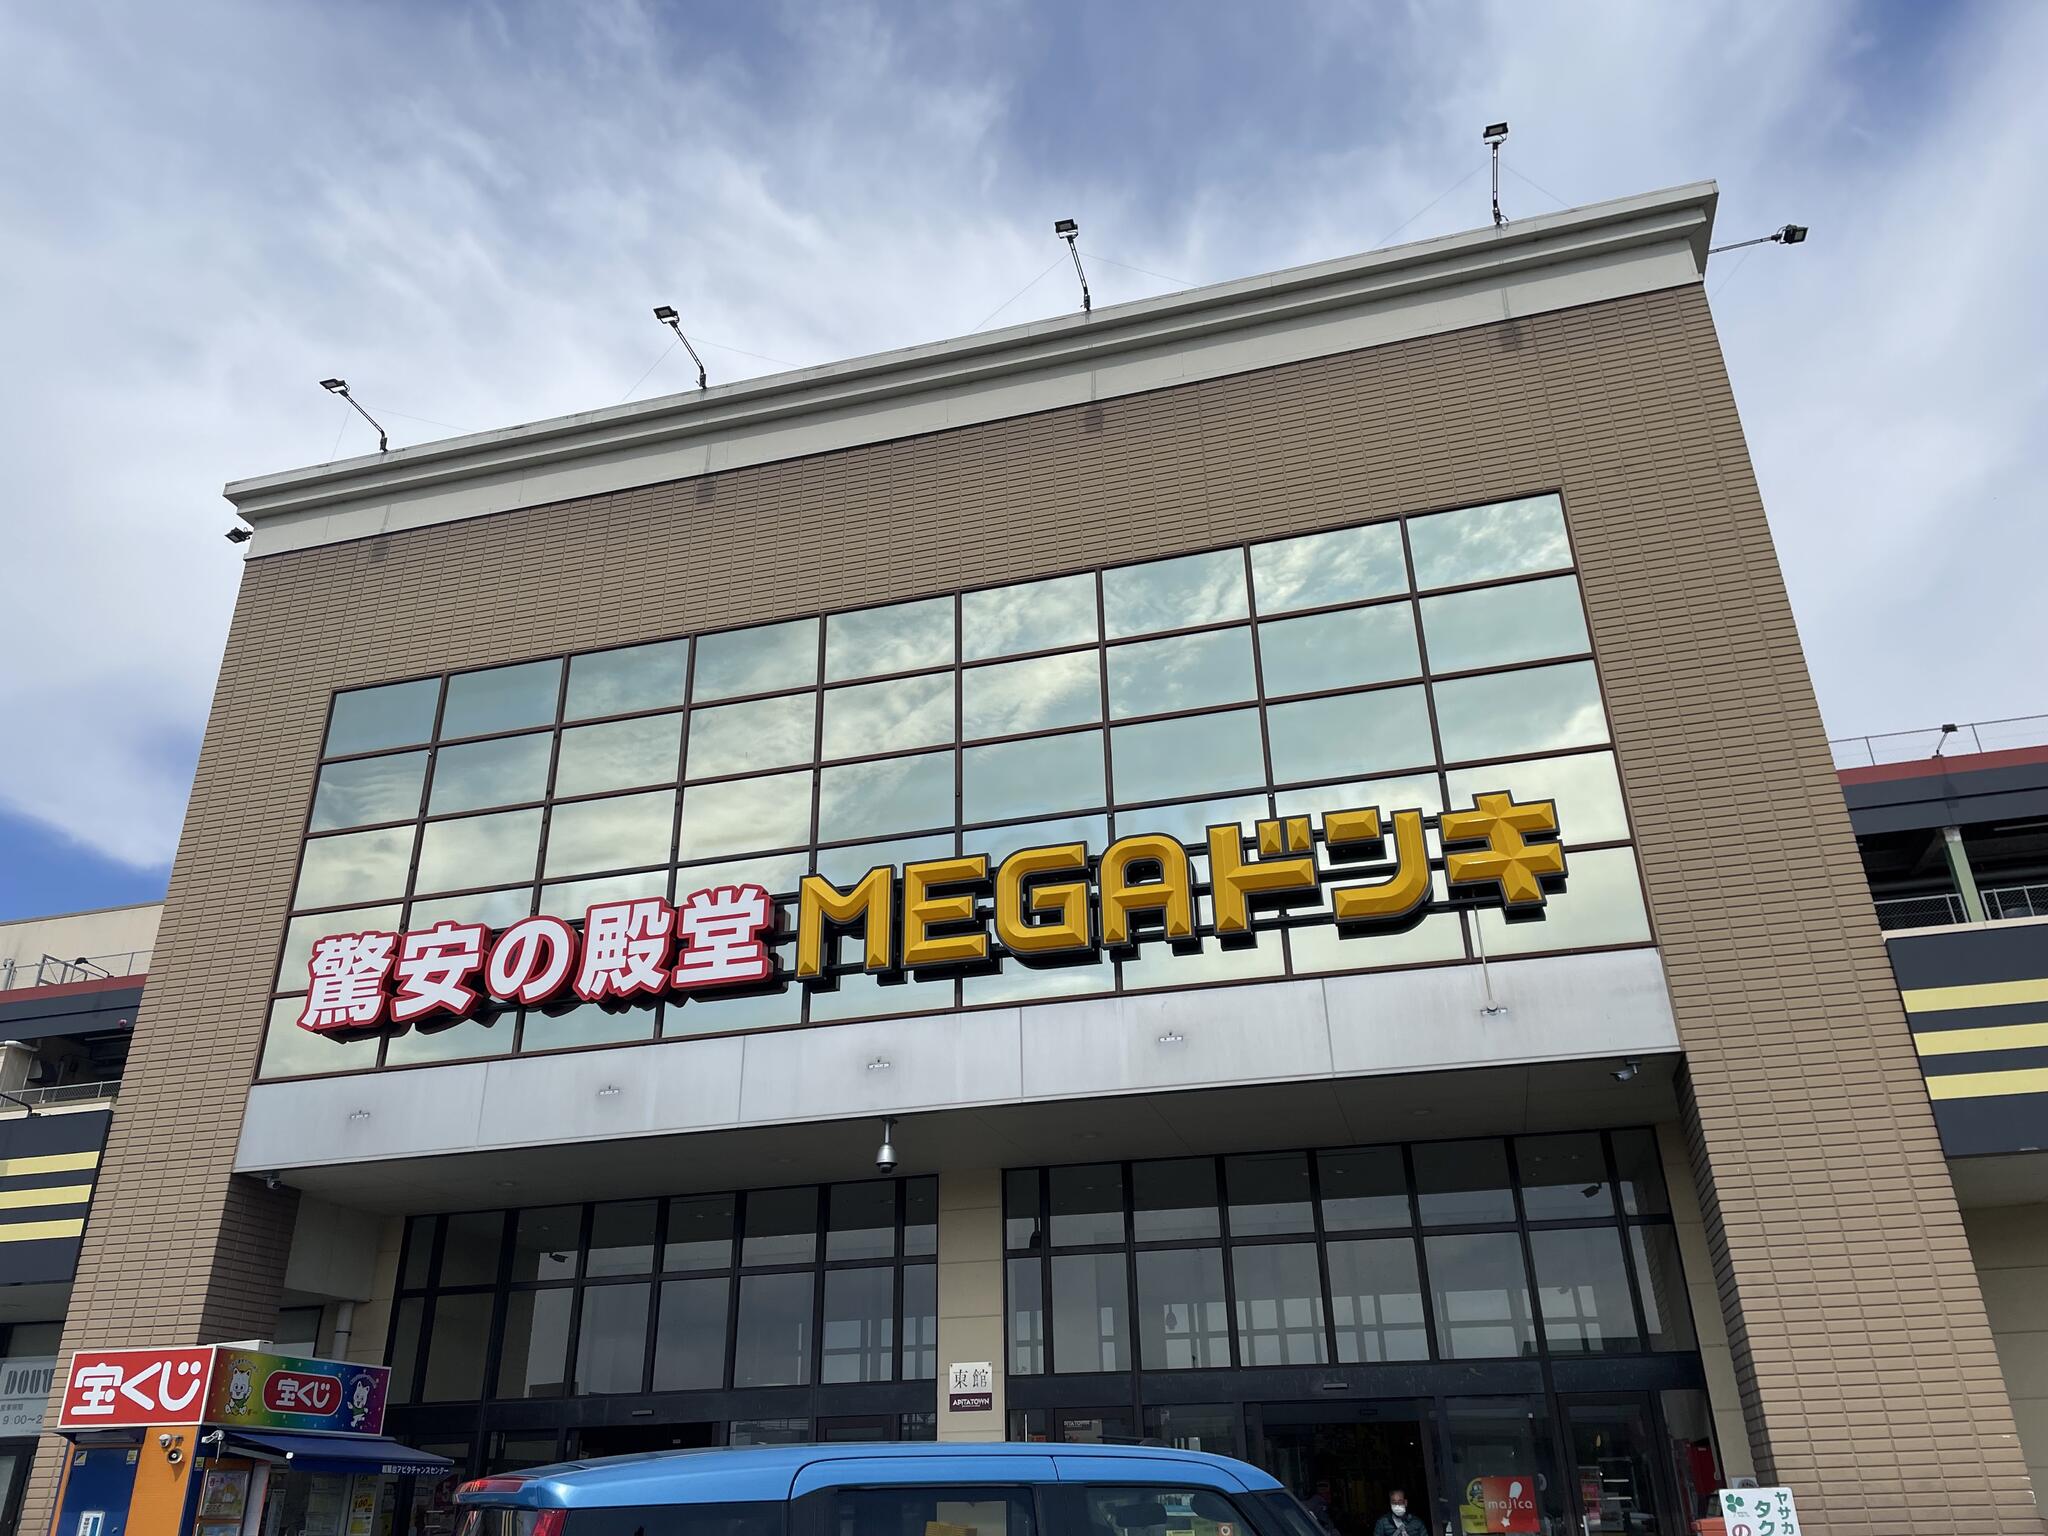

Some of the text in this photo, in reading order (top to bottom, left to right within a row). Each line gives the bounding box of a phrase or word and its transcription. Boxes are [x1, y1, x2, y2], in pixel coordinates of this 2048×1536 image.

[298, 790, 1569, 1031] 驚安の殿堂 MEGAドンキ
[70, 1359, 202, 1415] 宝くじ
[275, 1377, 331, 1409] 宝くじ
[952, 1368, 989, 1389] 東館
[1488, 1499, 1533, 1510] majica
[1774, 1491, 1795, 1535] ヤサカ
